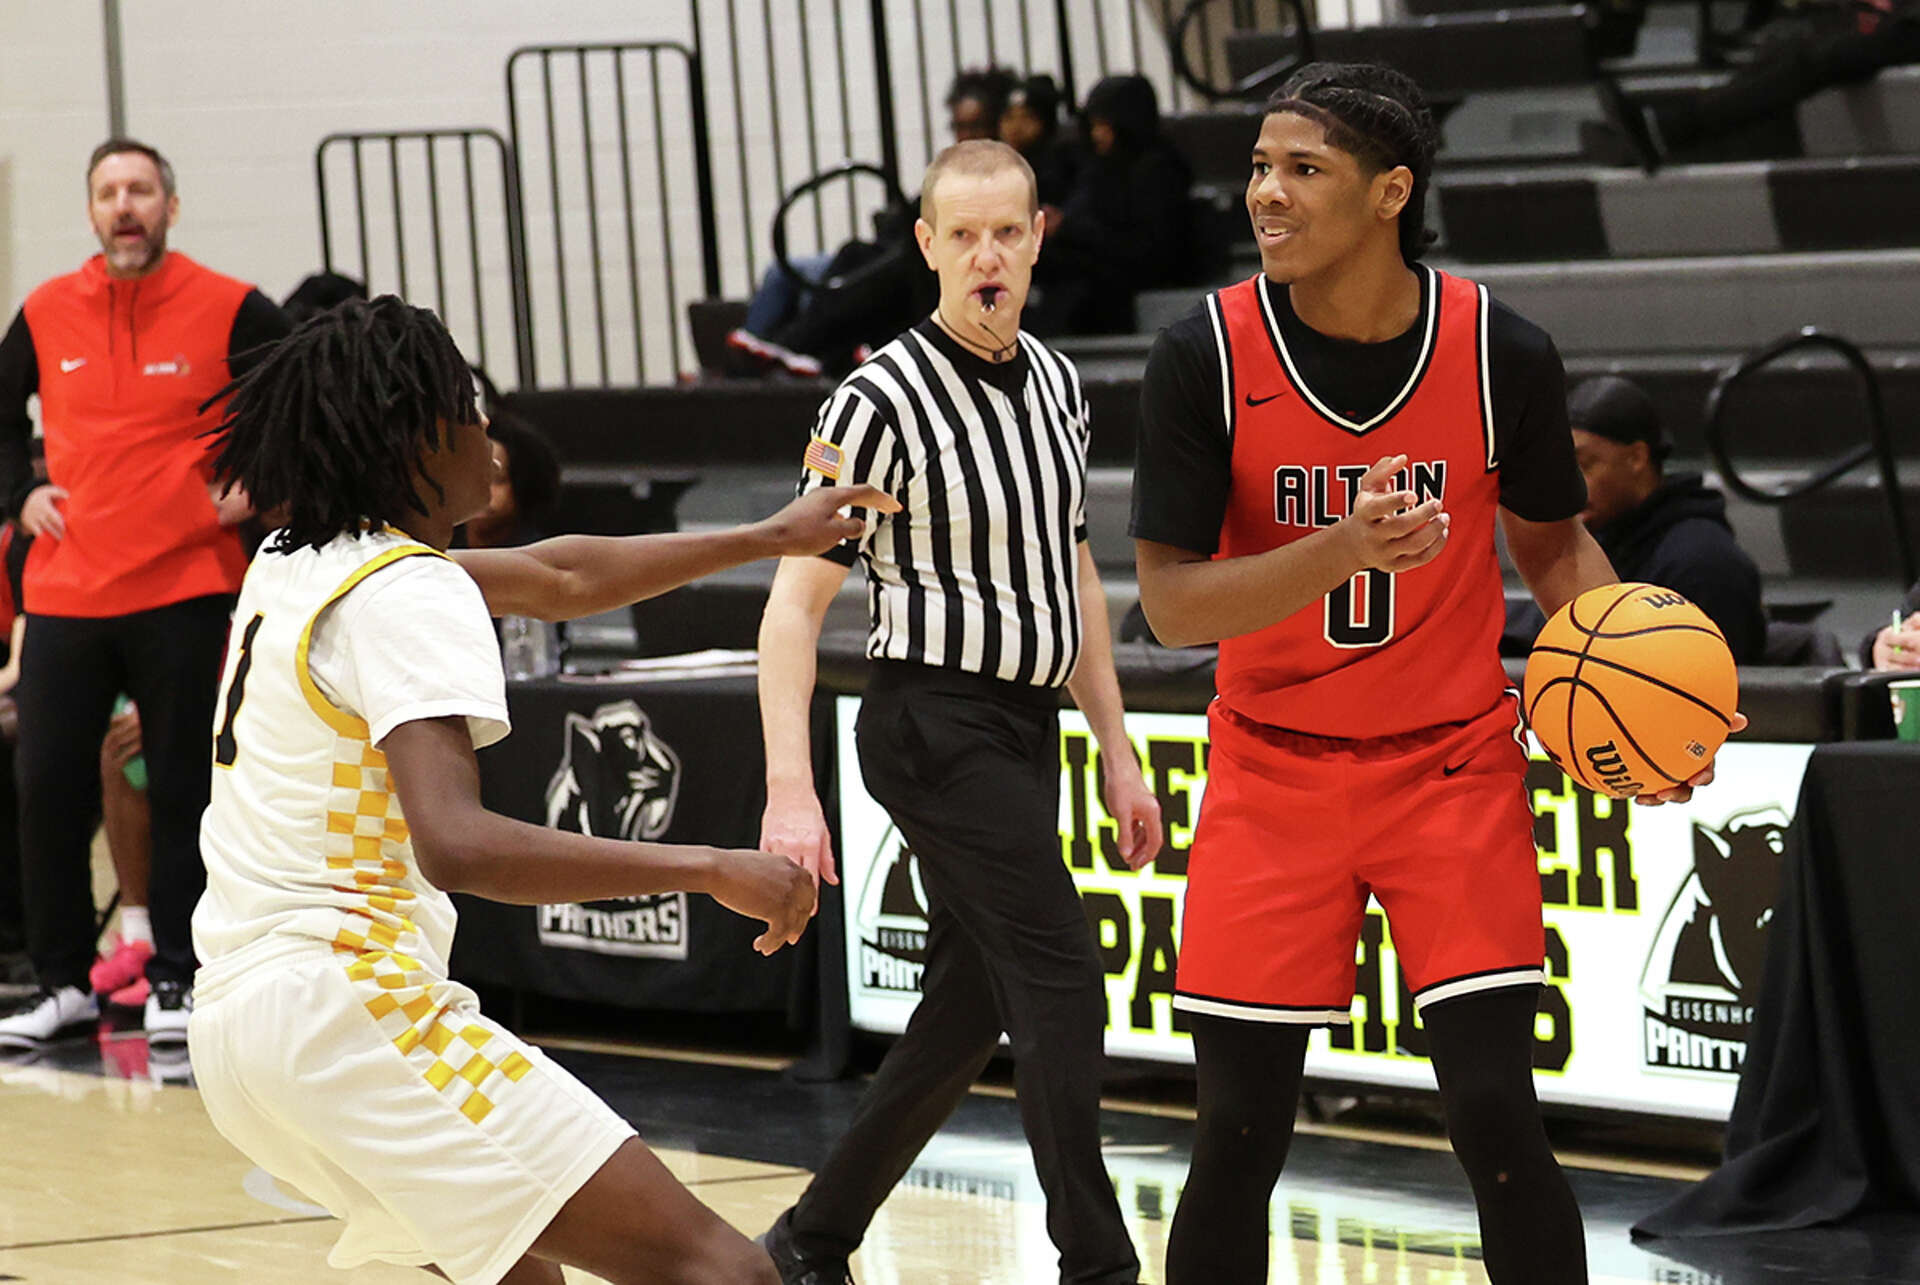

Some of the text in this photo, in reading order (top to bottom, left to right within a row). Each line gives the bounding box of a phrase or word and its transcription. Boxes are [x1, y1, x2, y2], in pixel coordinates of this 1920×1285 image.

[1323, 566, 1396, 648] 0
[1586, 739, 1645, 795] Wil
[880, 929, 927, 951] EISEN
[1645, 1016, 1747, 1070] PANT
